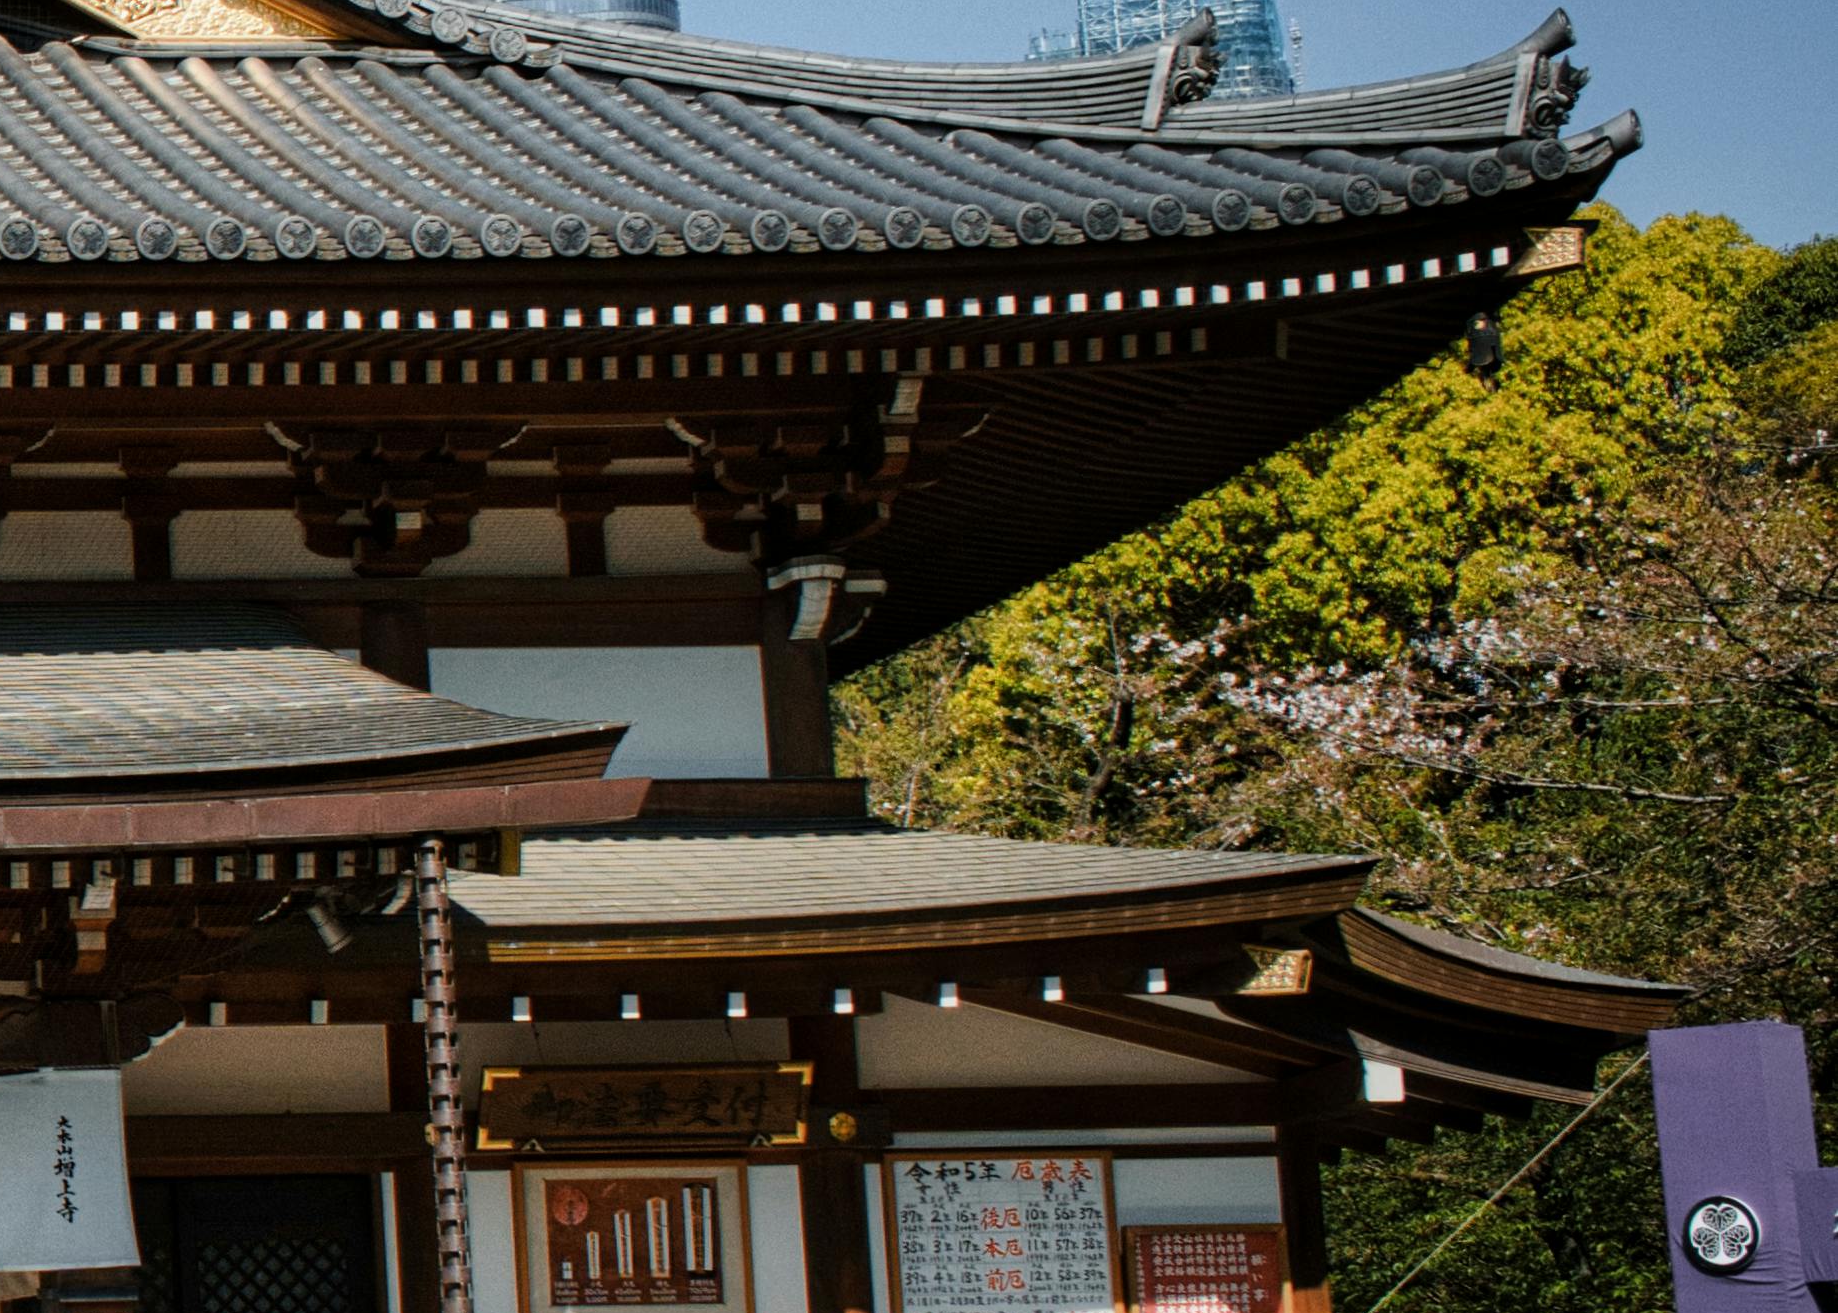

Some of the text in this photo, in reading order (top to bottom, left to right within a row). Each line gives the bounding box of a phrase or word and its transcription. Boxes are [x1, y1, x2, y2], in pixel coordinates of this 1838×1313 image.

[53, 1115, 79, 1224] 大本山増上寺
[904, 1159, 1093, 1183] 令和5年 厄歳表
[980, 1206, 1021, 1230] 後厄
[982, 1237, 1023, 1258] 本厄
[985, 1268, 1026, 1292] 前厄
